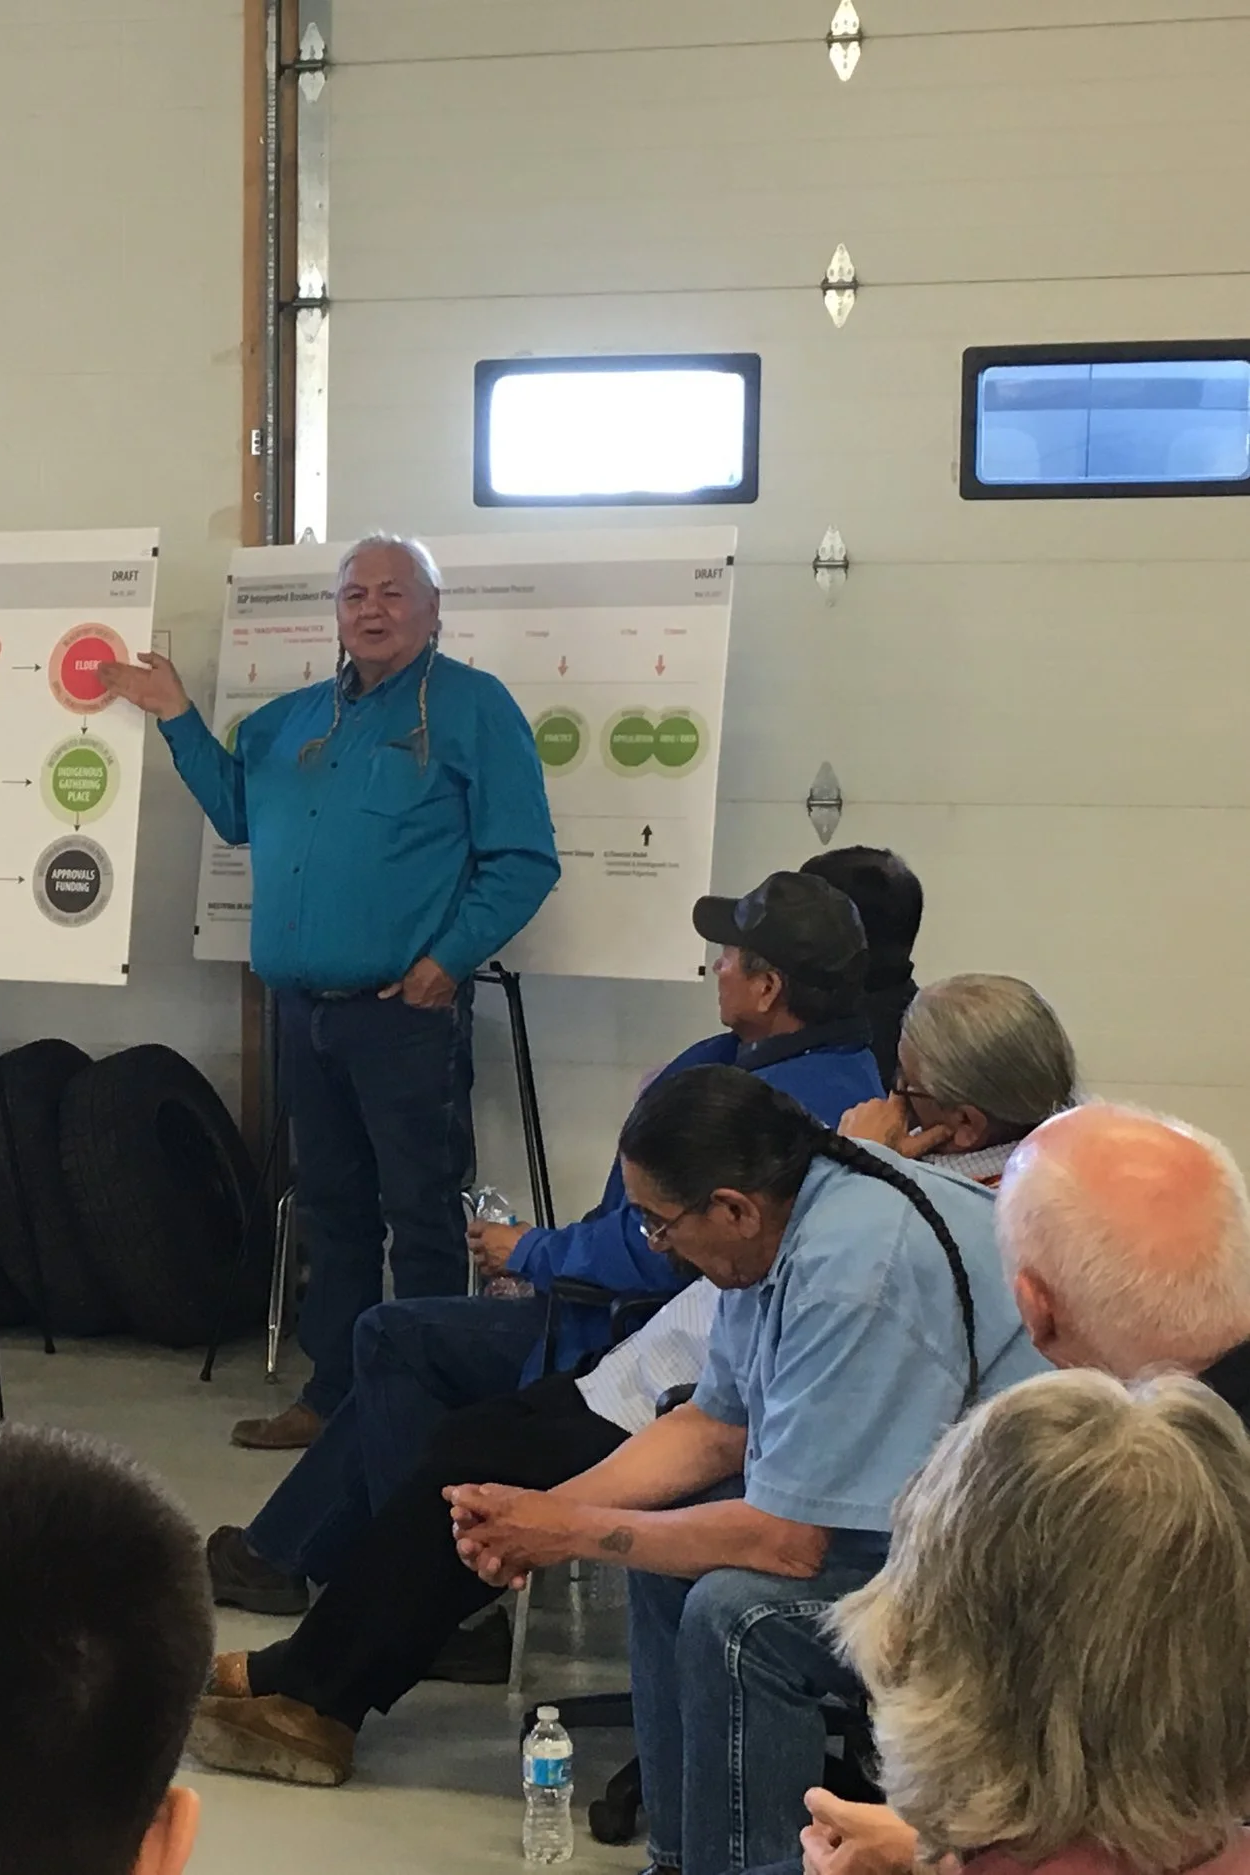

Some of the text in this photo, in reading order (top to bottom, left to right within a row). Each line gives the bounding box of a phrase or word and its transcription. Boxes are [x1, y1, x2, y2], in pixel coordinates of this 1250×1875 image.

[111, 570, 139, 581] DRAFT
[695, 568, 724, 579] DRAFT
[75, 660, 102, 671] ELDER
[57, 766, 103, 777] INDIGENOUS
[58, 778, 101, 790] GATHERING
[67, 791, 91, 802] PLACE
[51, 869, 95, 880] APPROVALS
[55, 881, 90, 893] FUNDING
